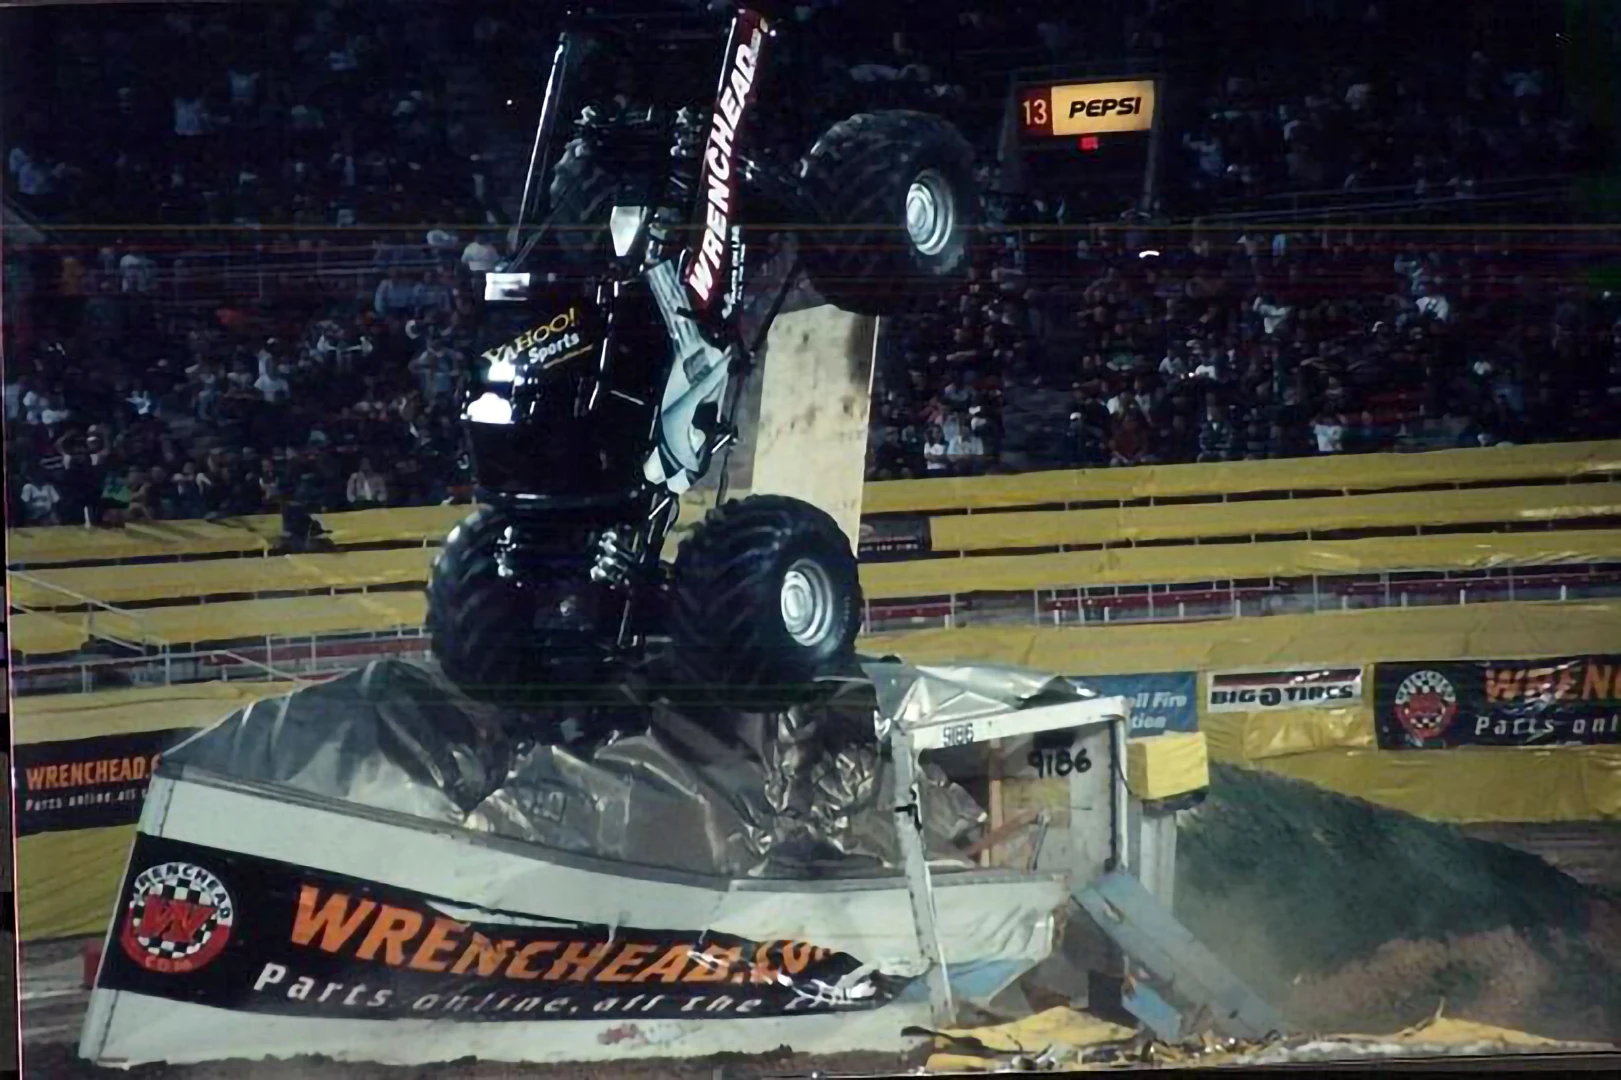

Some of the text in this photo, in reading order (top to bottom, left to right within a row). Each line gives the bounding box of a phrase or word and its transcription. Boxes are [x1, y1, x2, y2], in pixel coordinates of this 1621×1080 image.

[1023, 99, 1047, 125] 13
[1069, 97, 1142, 119] PEPSI
[481, 307, 576, 365] YAHOO!
[528, 332, 580, 364] Sports
[1211, 690, 1255, 704] BIG
[1475, 716, 1554, 735] Parts
[1028, 748, 1092, 778] 9186
[253, 962, 394, 1007] Parts
